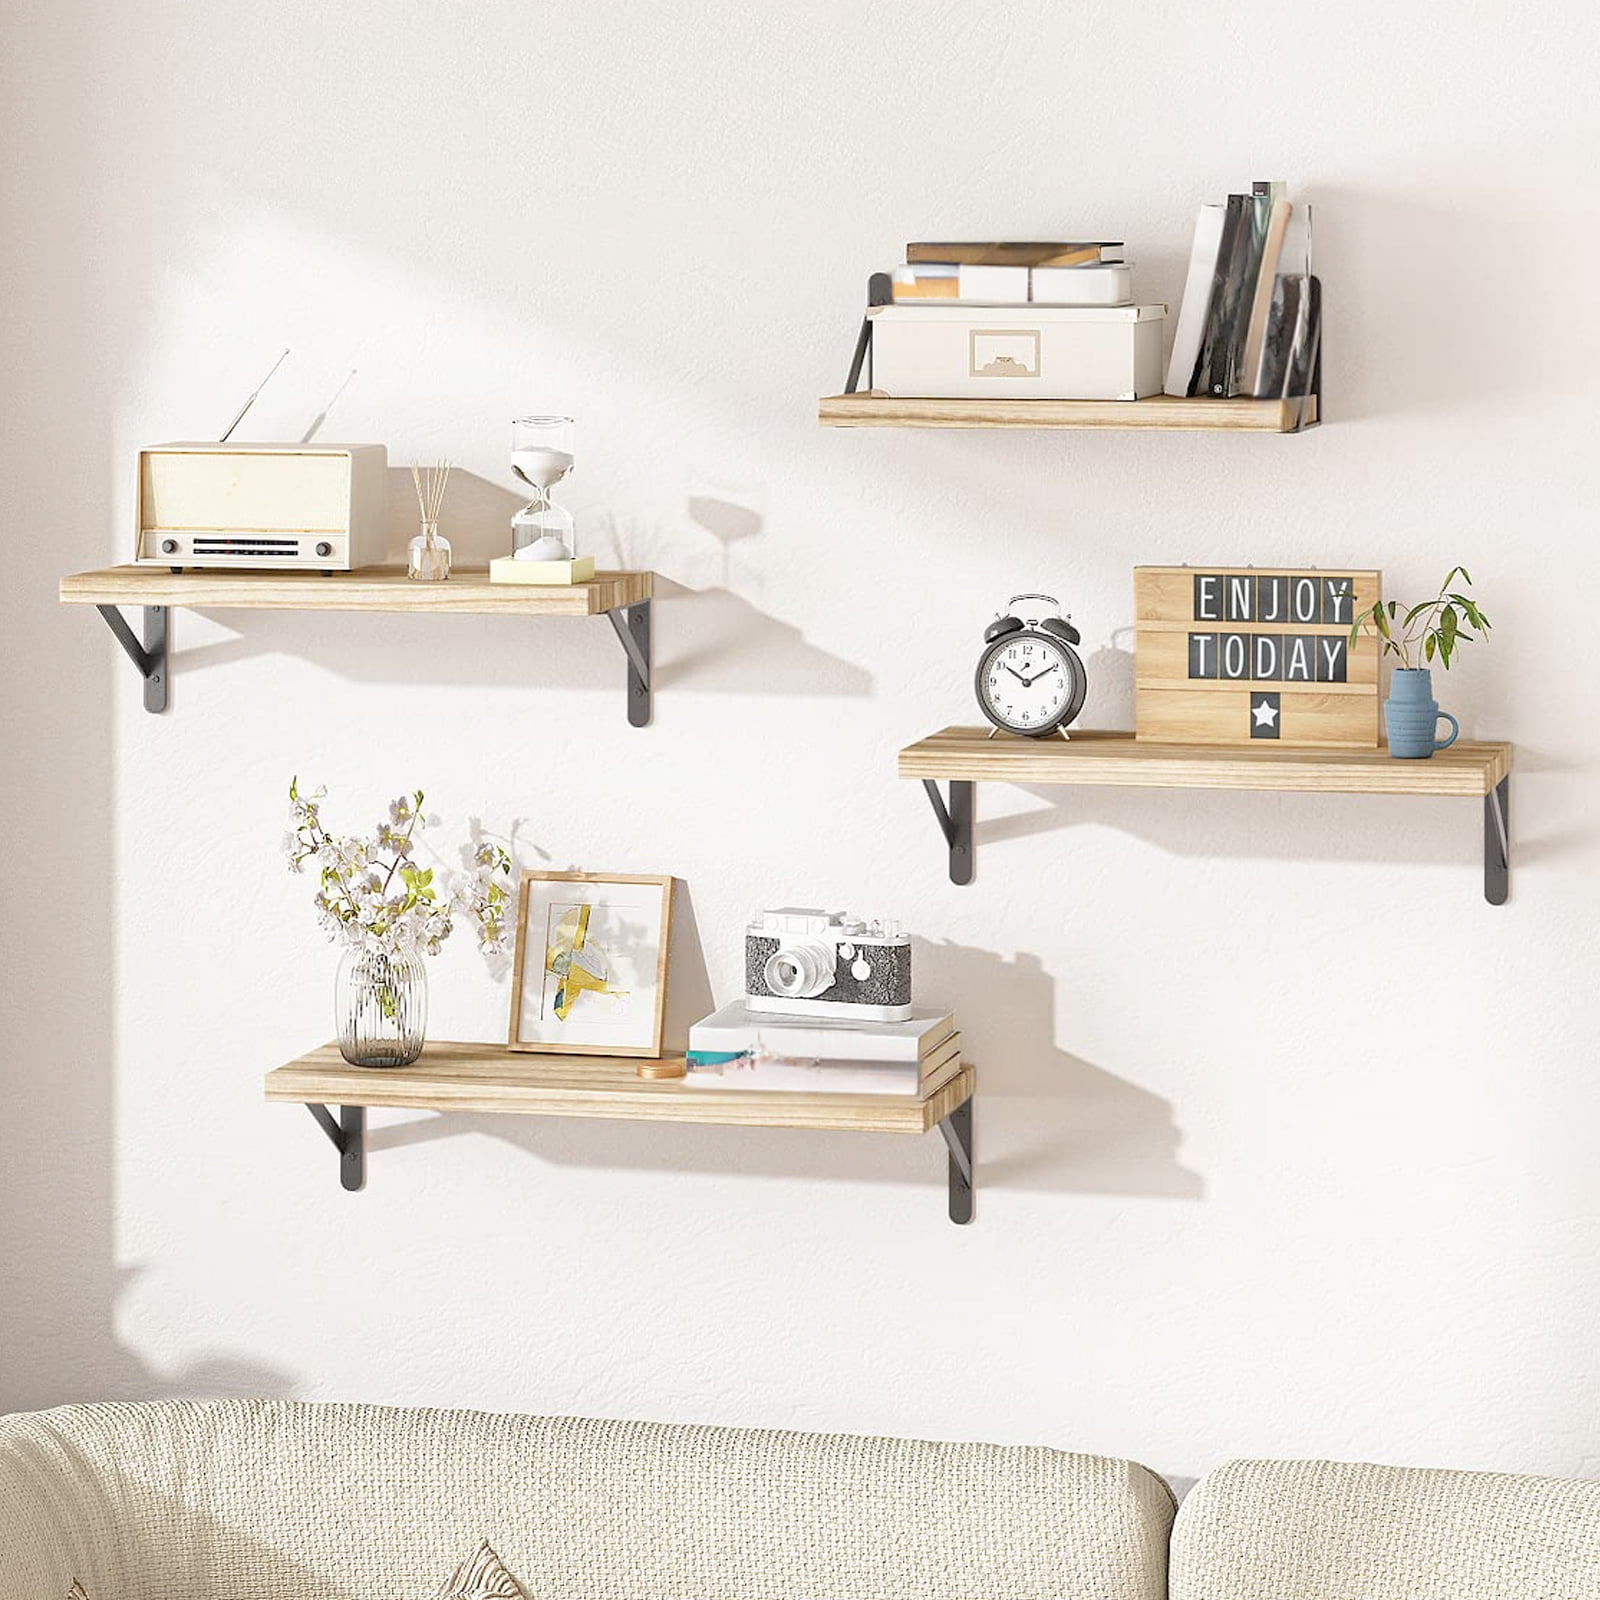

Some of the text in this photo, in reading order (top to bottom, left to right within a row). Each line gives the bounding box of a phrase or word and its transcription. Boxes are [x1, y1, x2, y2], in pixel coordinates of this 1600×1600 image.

[1200, 577, 1348, 623] ENJOY
[1008, 649, 1017, 659] 11
[1022, 645, 1033, 655] 12
[1042, 650, 1046, 660] 1
[1193, 635, 1342, 681] TODAY
[1052, 663, 1059, 672] 2
[990, 677, 997, 687] 9
[1057, 679, 1064, 689] 3
[994, 694, 1001, 703] 8
[1052, 696, 1058, 705] 4
[1006, 705, 1013, 716] 7
[1040, 705, 1048, 716] 5
[1022, 711, 1030, 721] 6
